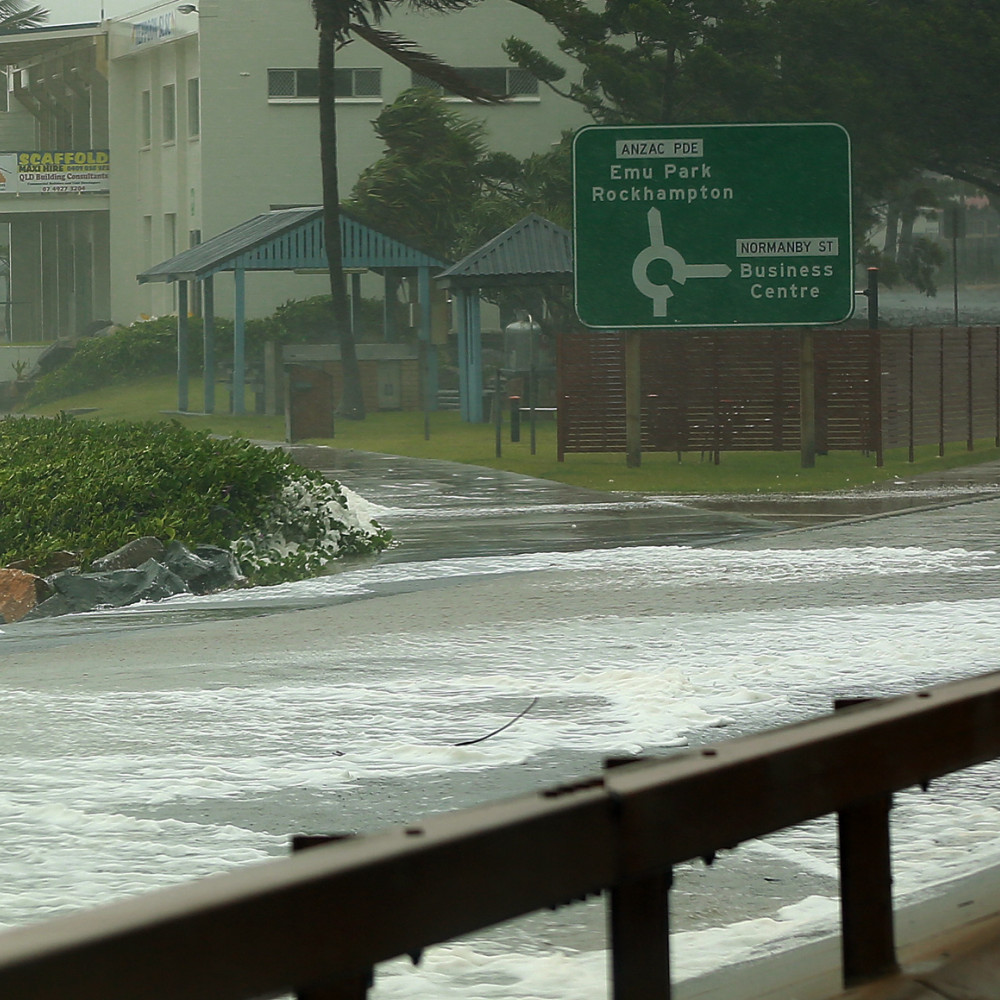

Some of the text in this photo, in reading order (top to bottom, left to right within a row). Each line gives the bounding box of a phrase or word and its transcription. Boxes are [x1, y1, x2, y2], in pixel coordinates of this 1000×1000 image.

[621, 142, 699, 155] ANZAC PDE
[19, 152, 109, 165] SCAFFOLD
[19, 174, 35, 182] QLD
[610, 164, 712, 180] Emu Park
[592, 186, 734, 203] Rockhampton
[741, 241, 834, 254] NORMANBY ST
[740, 263, 834, 278] Business
[750, 284, 820, 299] Centre
